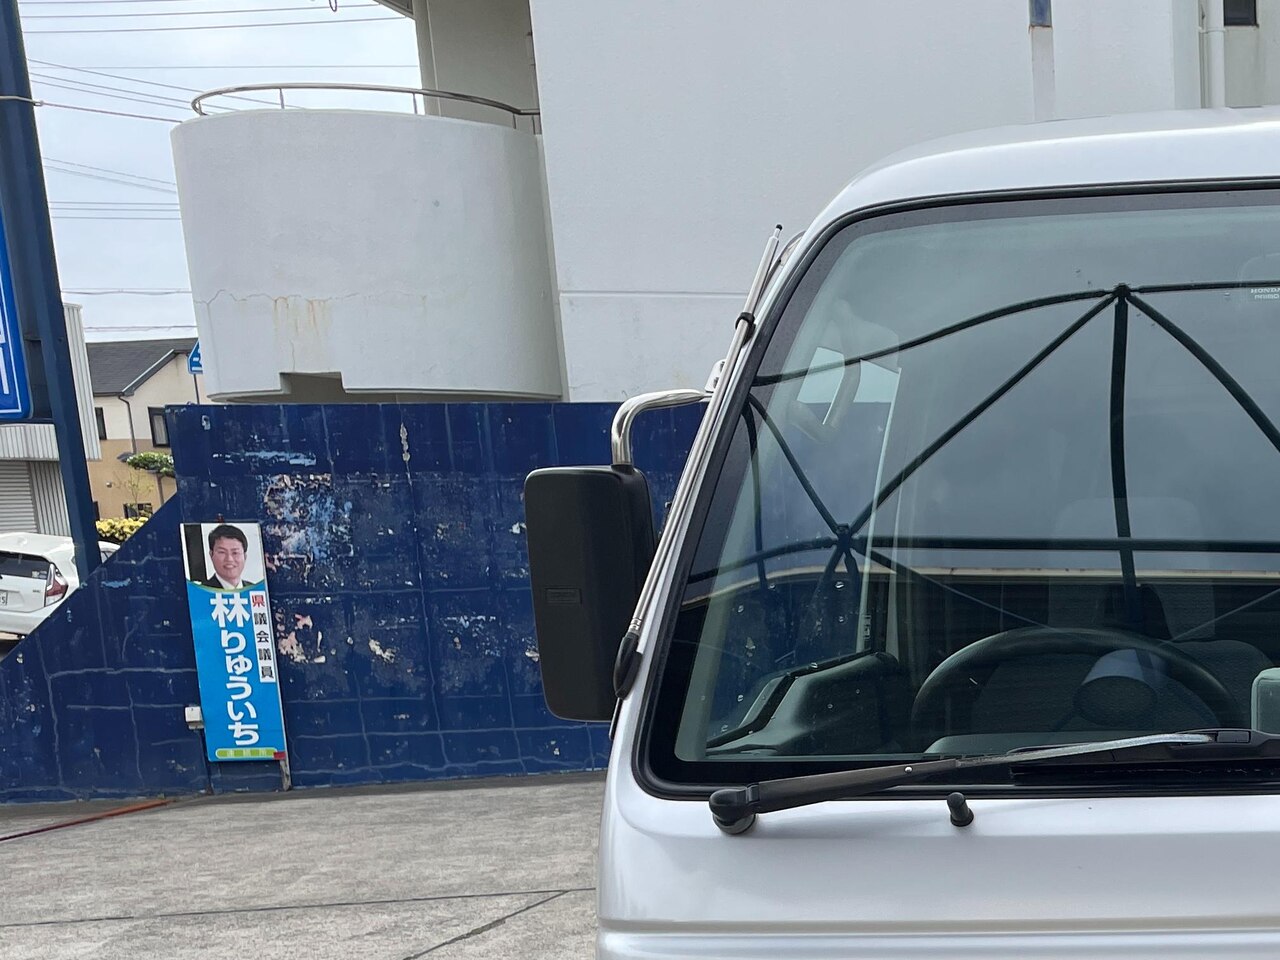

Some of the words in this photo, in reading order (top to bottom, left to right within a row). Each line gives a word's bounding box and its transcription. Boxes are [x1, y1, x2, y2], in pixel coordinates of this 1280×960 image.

[210, 592, 260, 746] 林りゅういち
[251, 594, 275, 679] 県議会議員
